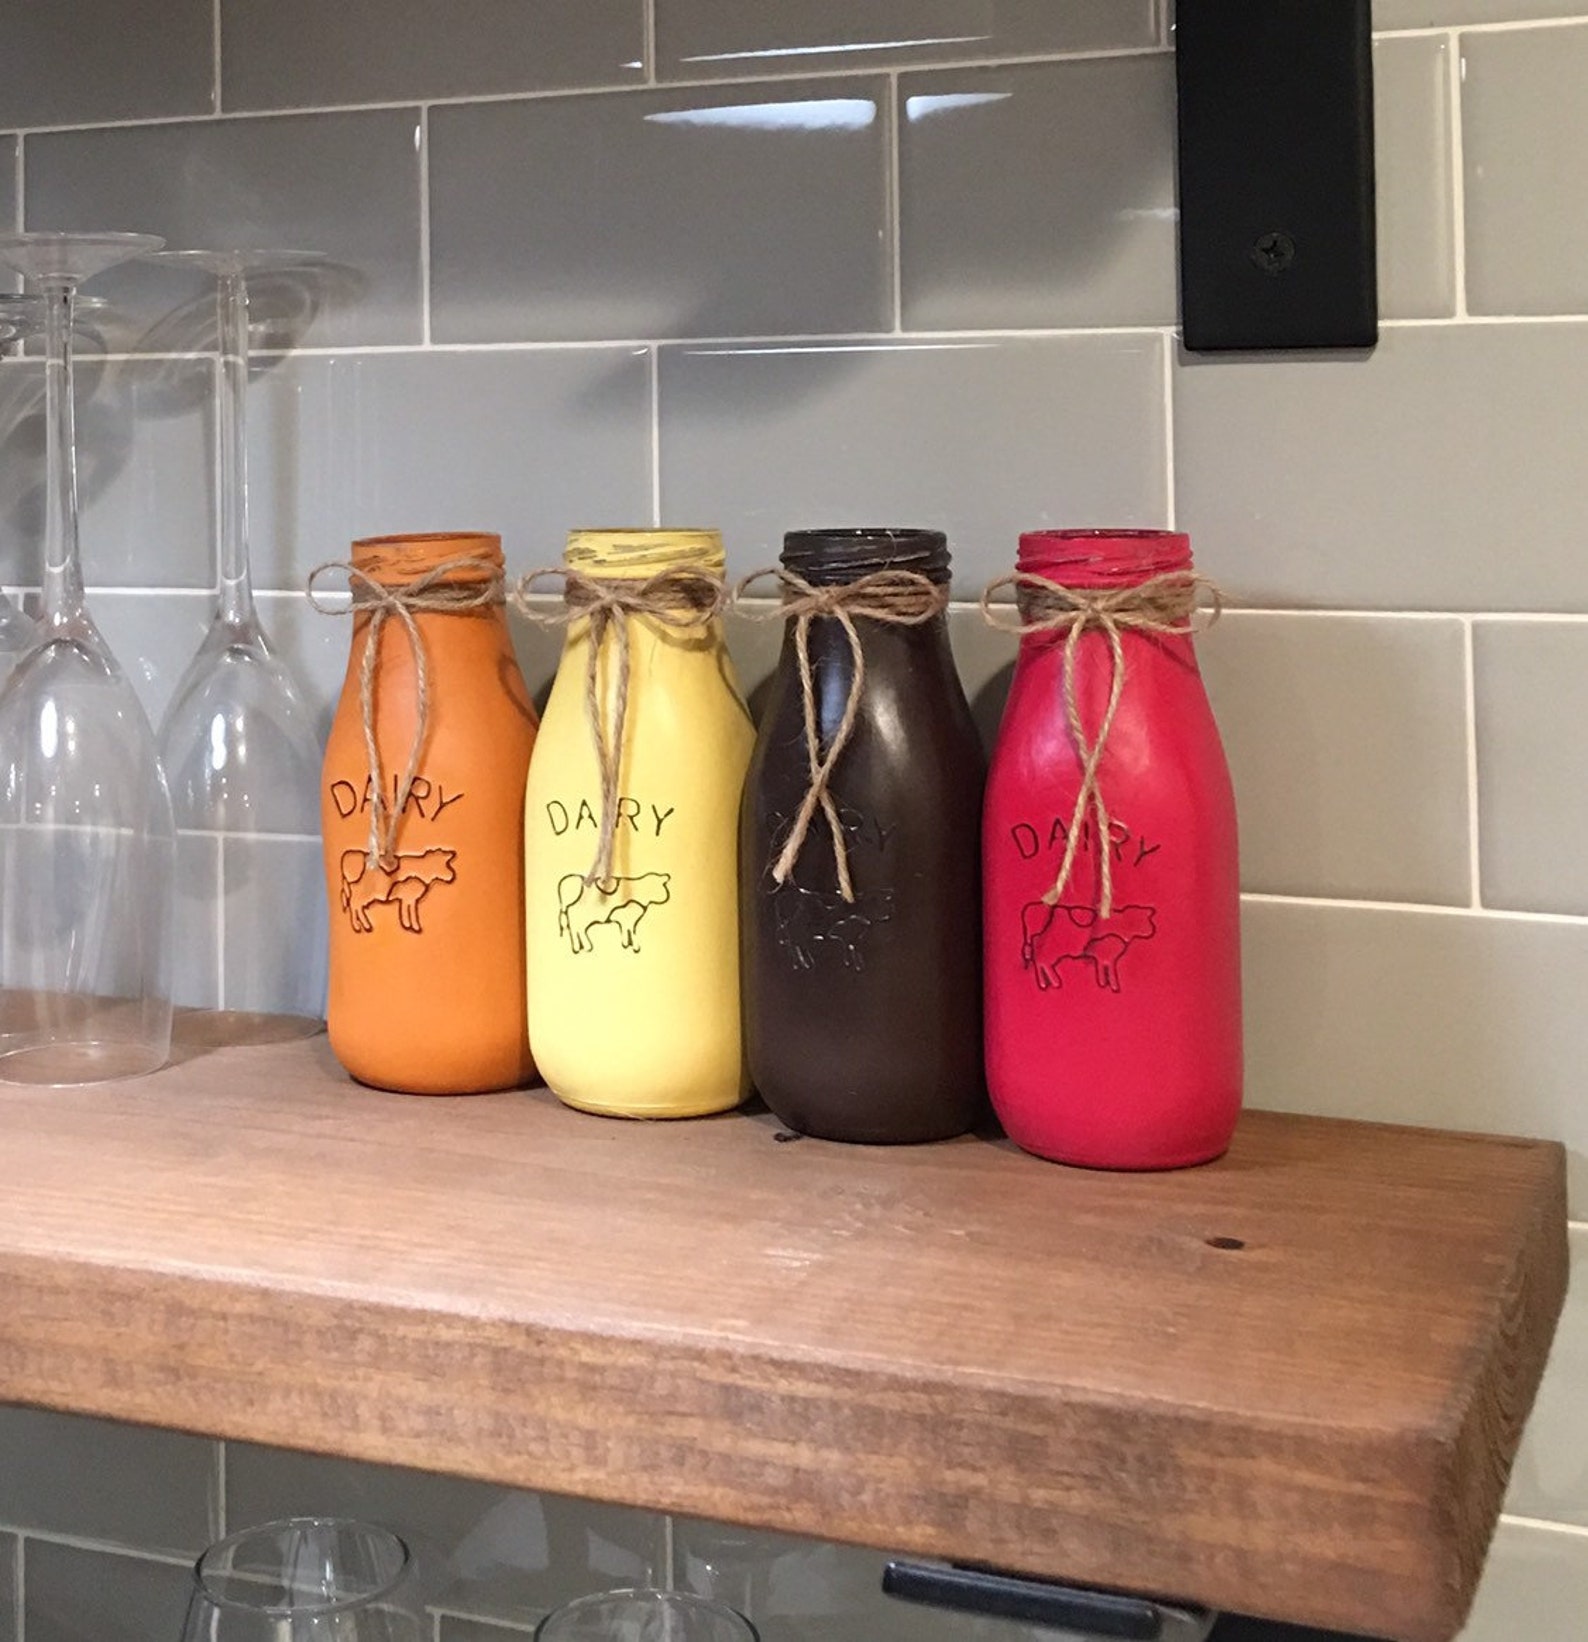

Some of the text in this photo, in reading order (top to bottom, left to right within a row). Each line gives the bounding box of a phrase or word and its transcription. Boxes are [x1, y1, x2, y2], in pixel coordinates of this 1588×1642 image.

[330, 774, 464, 821] DAIRY
[546, 797, 674, 836] DARY
[1011, 816, 1161, 867] DAIRY
